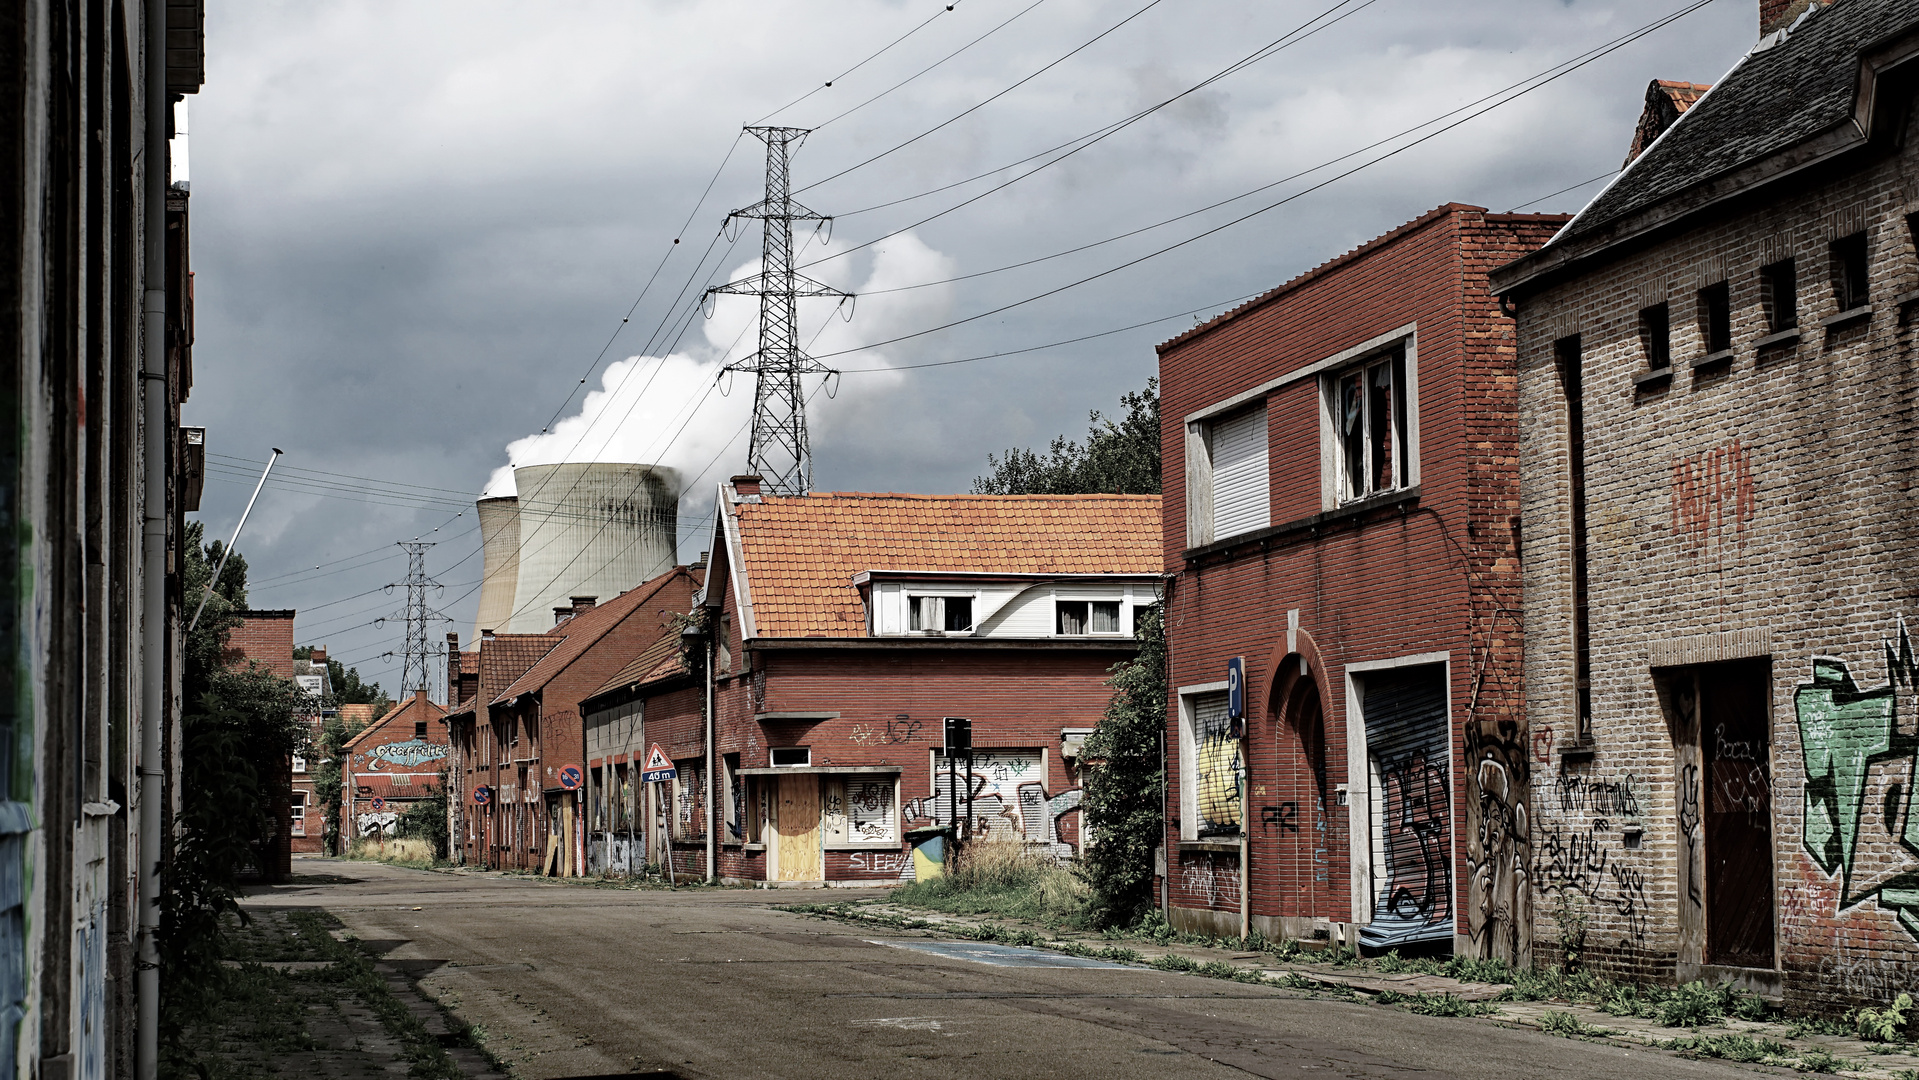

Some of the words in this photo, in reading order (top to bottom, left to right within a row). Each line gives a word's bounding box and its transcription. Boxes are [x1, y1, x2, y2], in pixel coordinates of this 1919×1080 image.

[1229, 667, 1238, 709] P
[648, 771, 660, 781] 40
[661, 772, 671, 780] m
